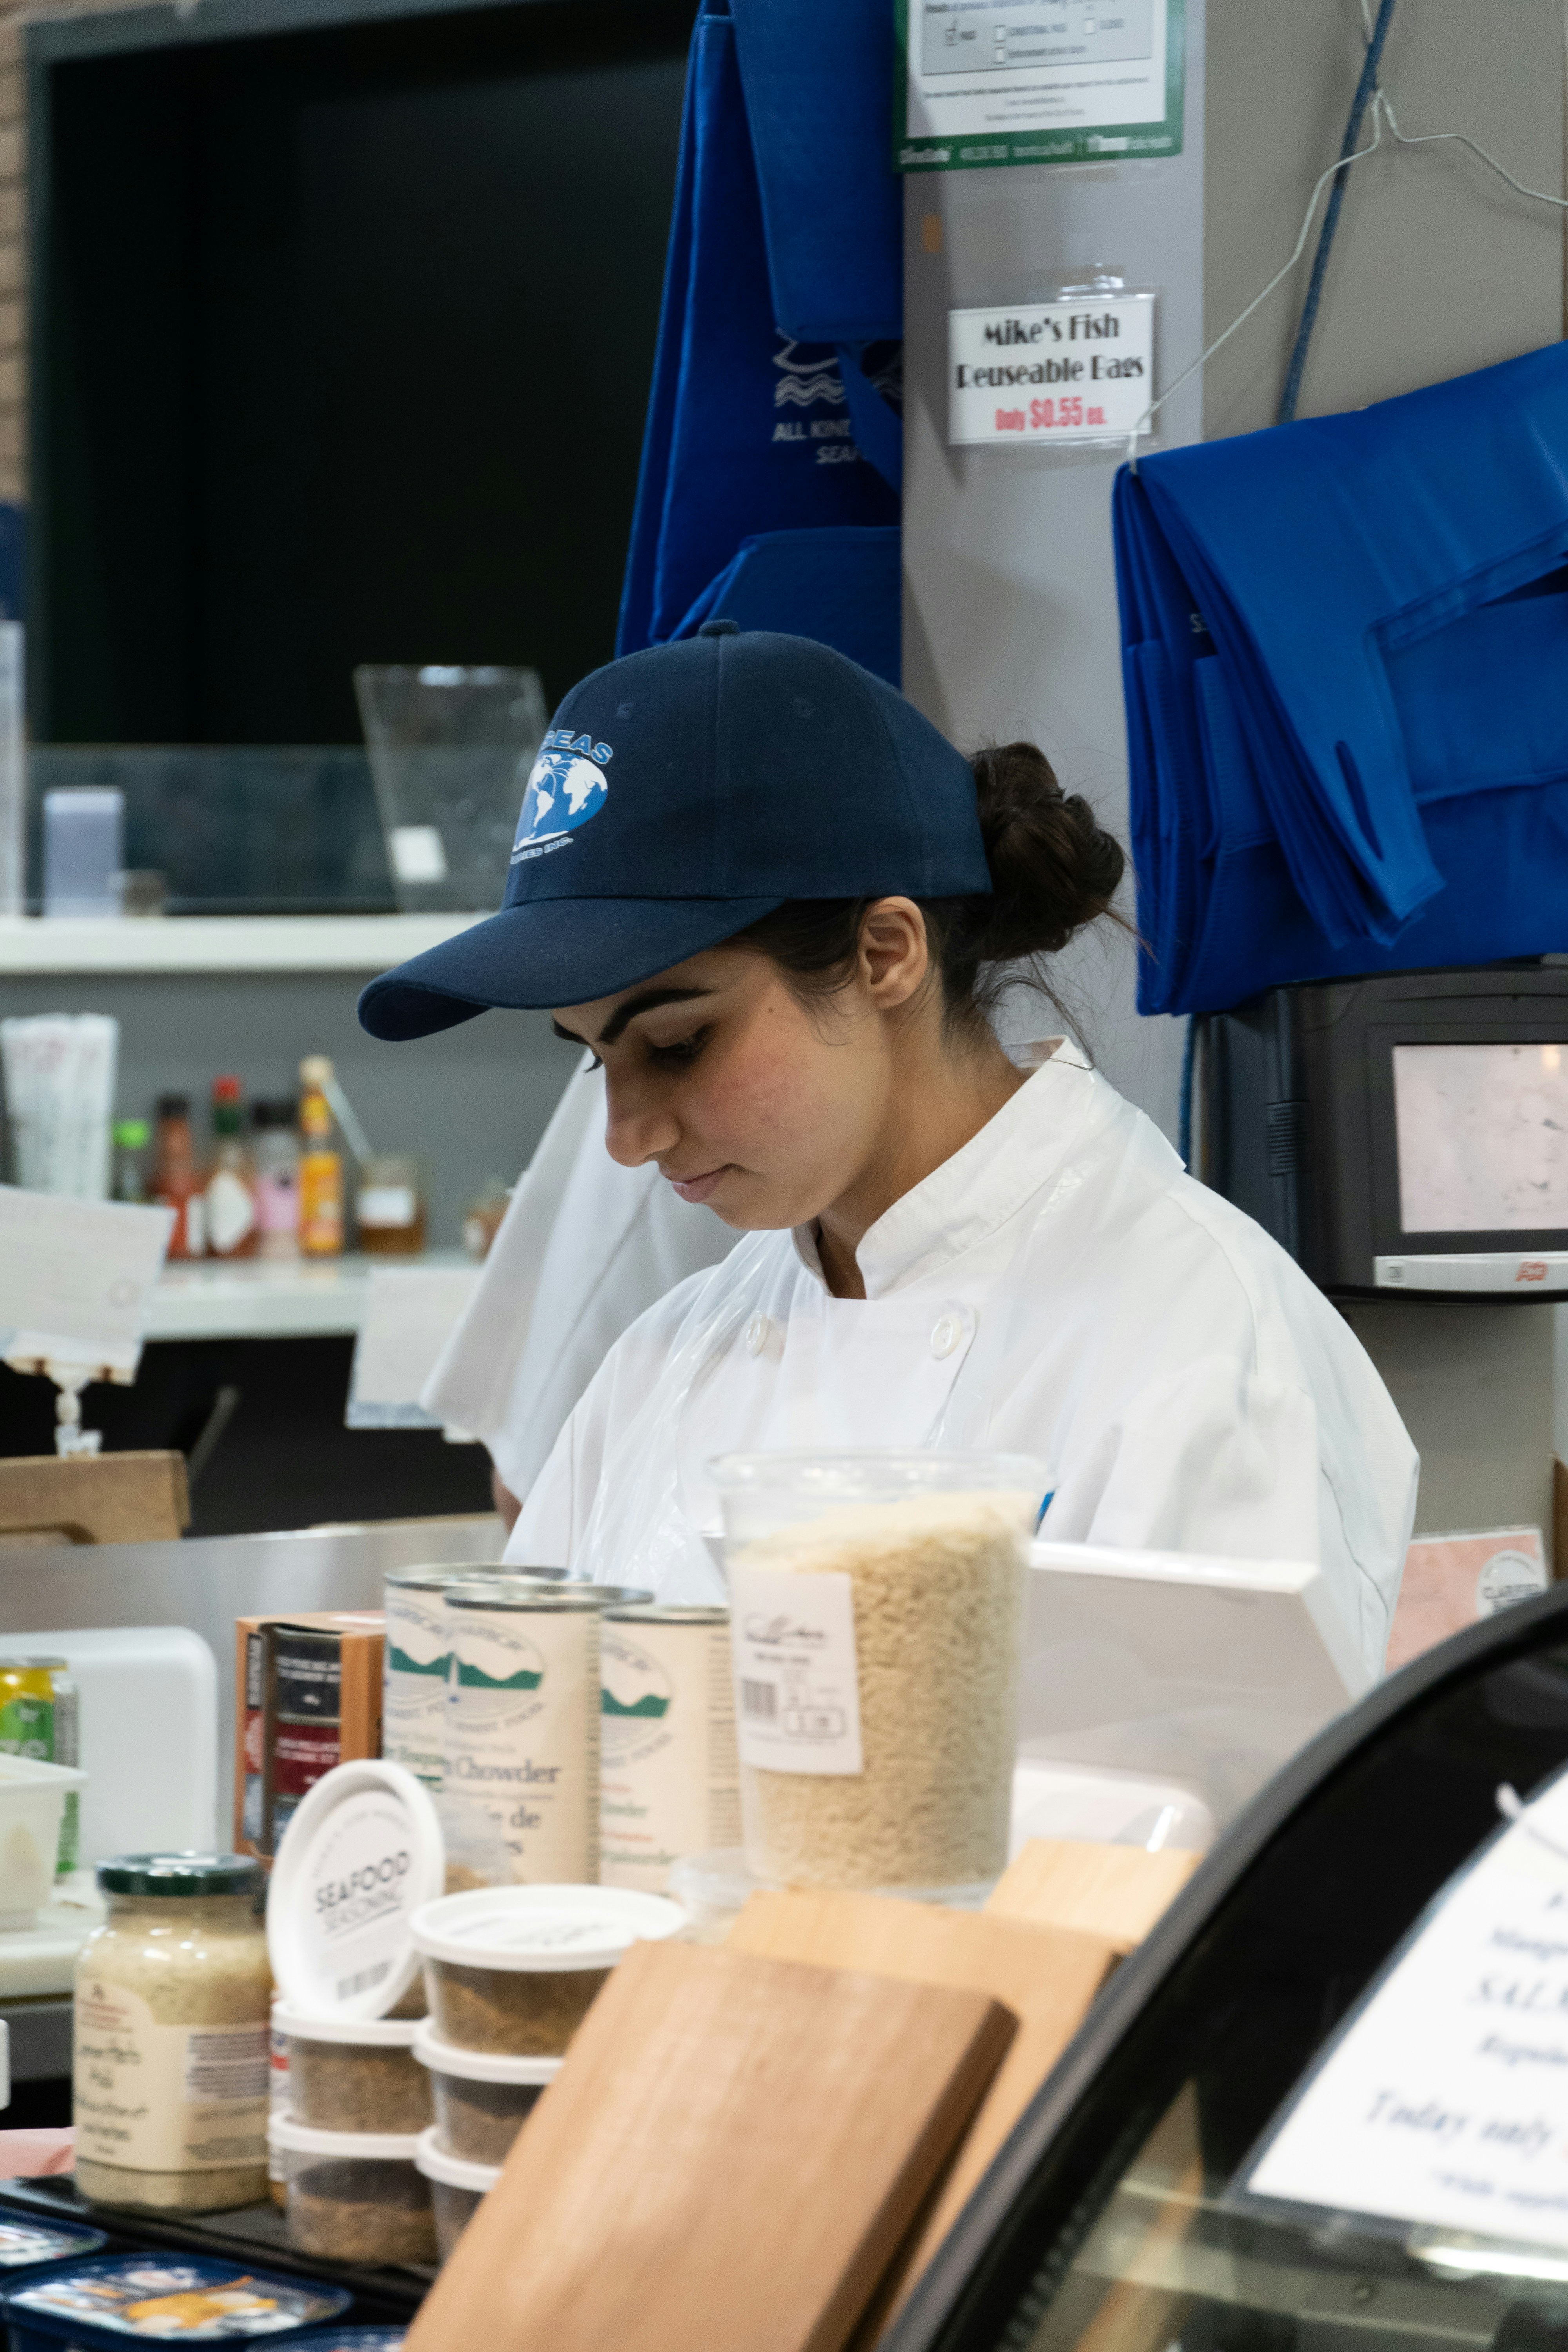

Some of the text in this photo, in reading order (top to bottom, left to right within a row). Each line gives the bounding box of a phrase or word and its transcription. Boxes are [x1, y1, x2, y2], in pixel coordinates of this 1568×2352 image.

[983, 313, 1119, 346] Mike's Fish
[543, 837, 574, 854] INC.
[457, 1756, 561, 1784] Chowder
[510, 1806, 541, 1829] de
[316, 1850, 410, 1914] SEAFOOD
